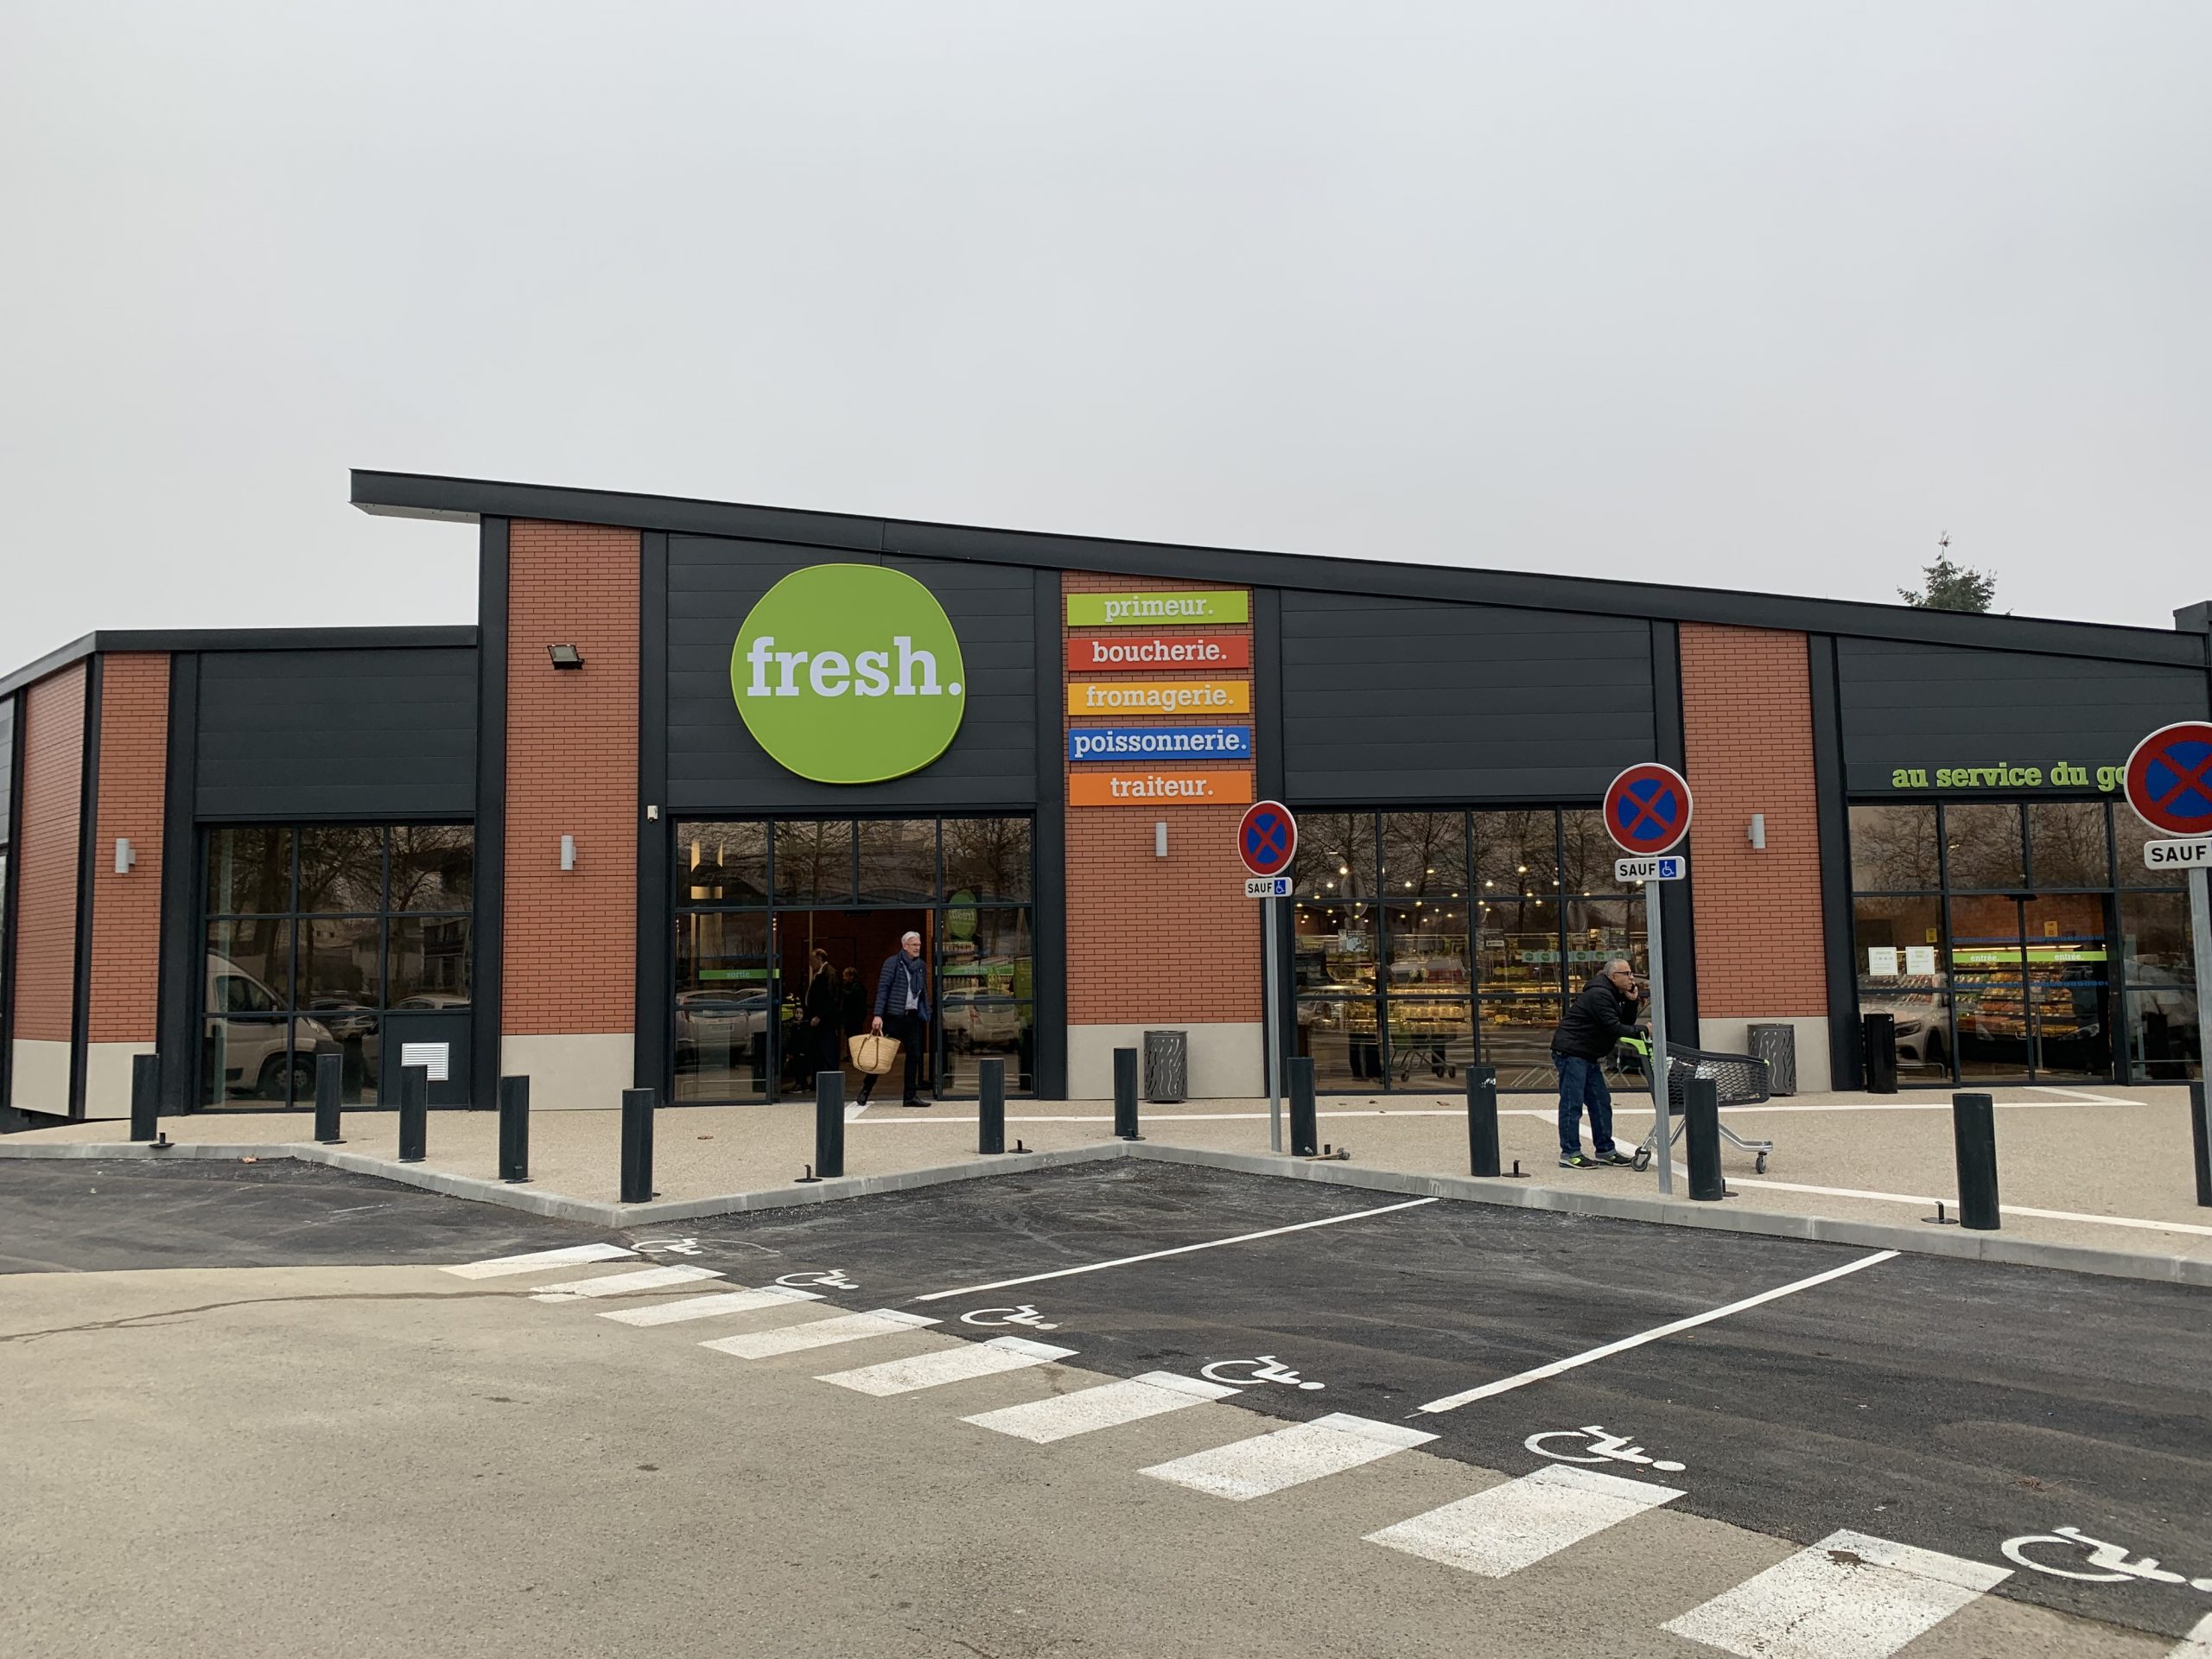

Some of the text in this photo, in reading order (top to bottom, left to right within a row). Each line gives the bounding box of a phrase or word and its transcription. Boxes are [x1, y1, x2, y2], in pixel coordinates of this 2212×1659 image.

[1104, 595, 1213, 622] primeur.
[1092, 639, 1227, 662] boucherie.
[747, 635, 962, 697] fresh.
[1086, 684, 1234, 711] fromagerie.
[1074, 728, 1246, 758] poissonnerie.
[1110, 775, 1213, 797] traiteur.
[1891, 761, 2126, 792] au service du go
[2151, 844, 2207, 862] SAUF
[1619, 862, 1656, 876] SAUF
[1248, 882, 1272, 893] SAUF
[1970, 953, 1999, 962] entrée.
[2054, 951, 2083, 961] entrée.
